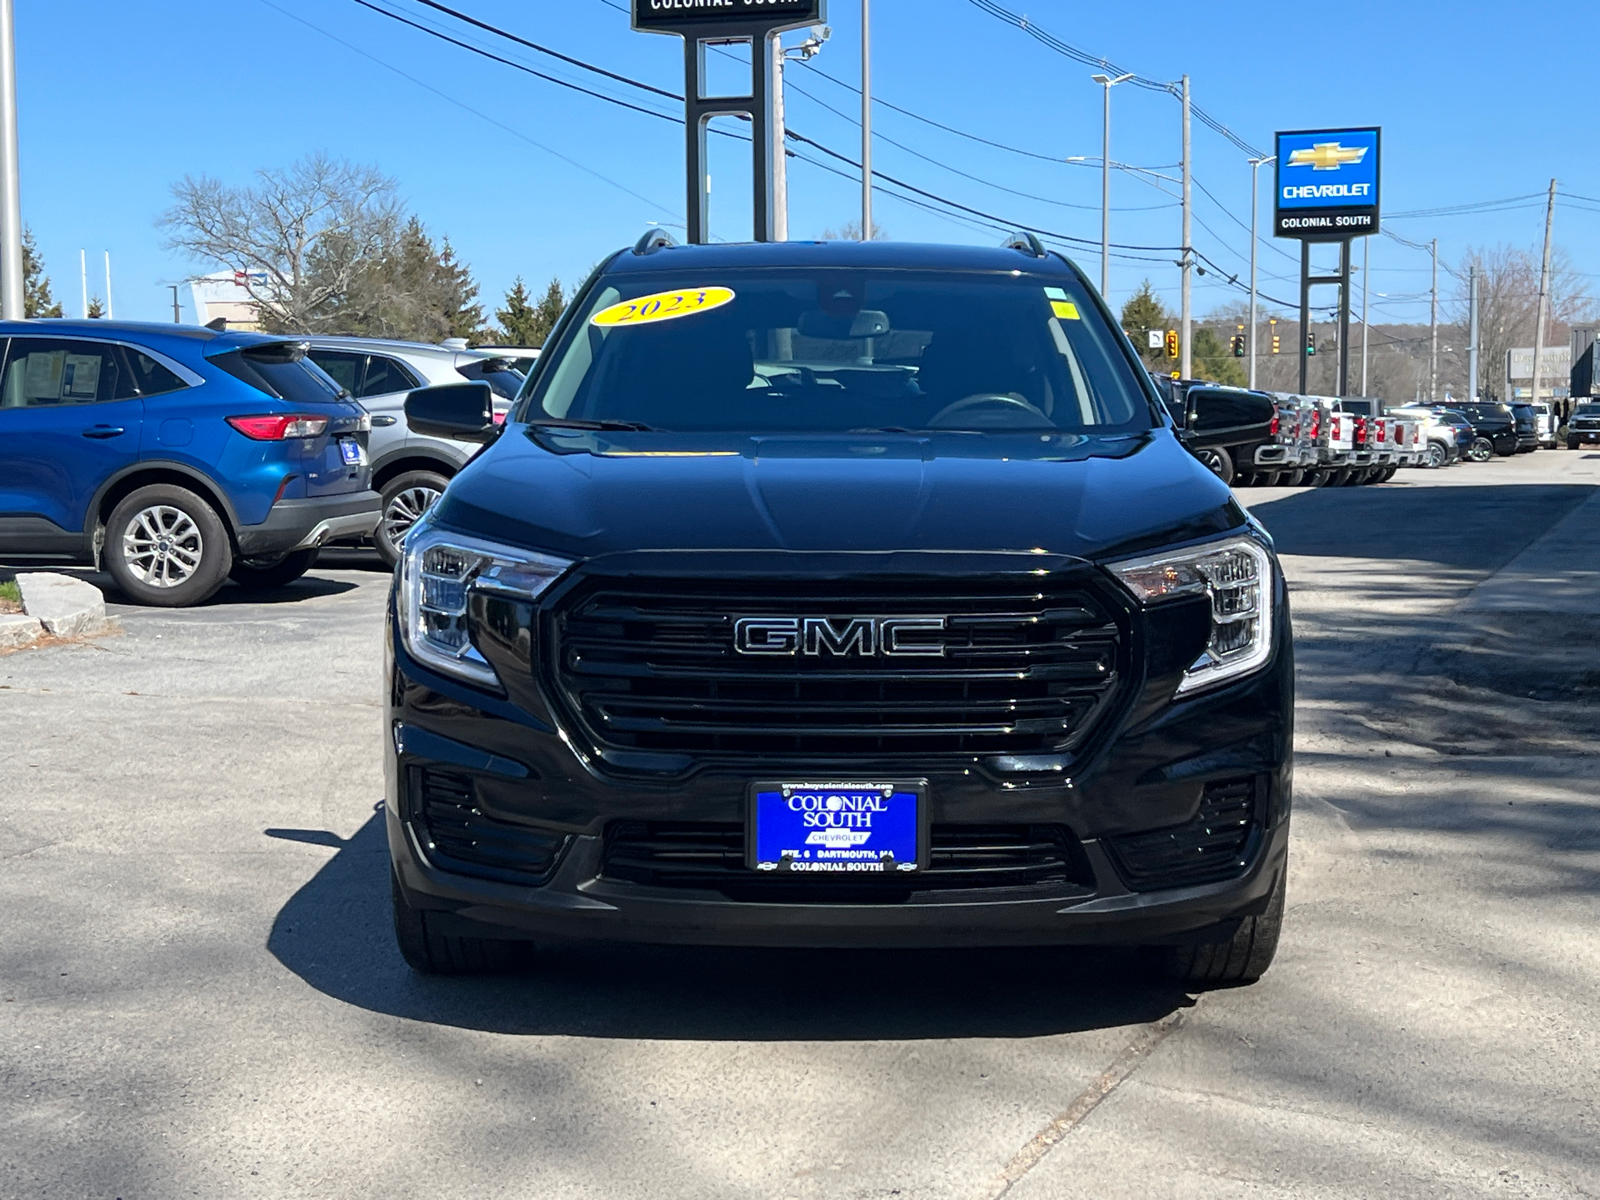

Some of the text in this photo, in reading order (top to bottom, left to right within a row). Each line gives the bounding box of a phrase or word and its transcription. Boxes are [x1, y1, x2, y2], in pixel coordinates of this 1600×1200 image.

[1283, 183, 1371, 199] CHEVROLET
[1281, 215, 1371, 228] COLONIAL SOUTH
[616, 292, 706, 322] 2023
[733, 617, 945, 657] GMC
[781, 782, 894, 790] www.buycolonialsouth.com
[788, 795, 888, 811] COLONIAL
[803, 812, 872, 828] SOUTH
[812, 833, 864, 842] CHEVROLET
[803, 849, 811, 858] 6
[816, 849, 878, 860] DARTMOUTH,
[790, 862, 885, 871] COLONIAL SOUTH
